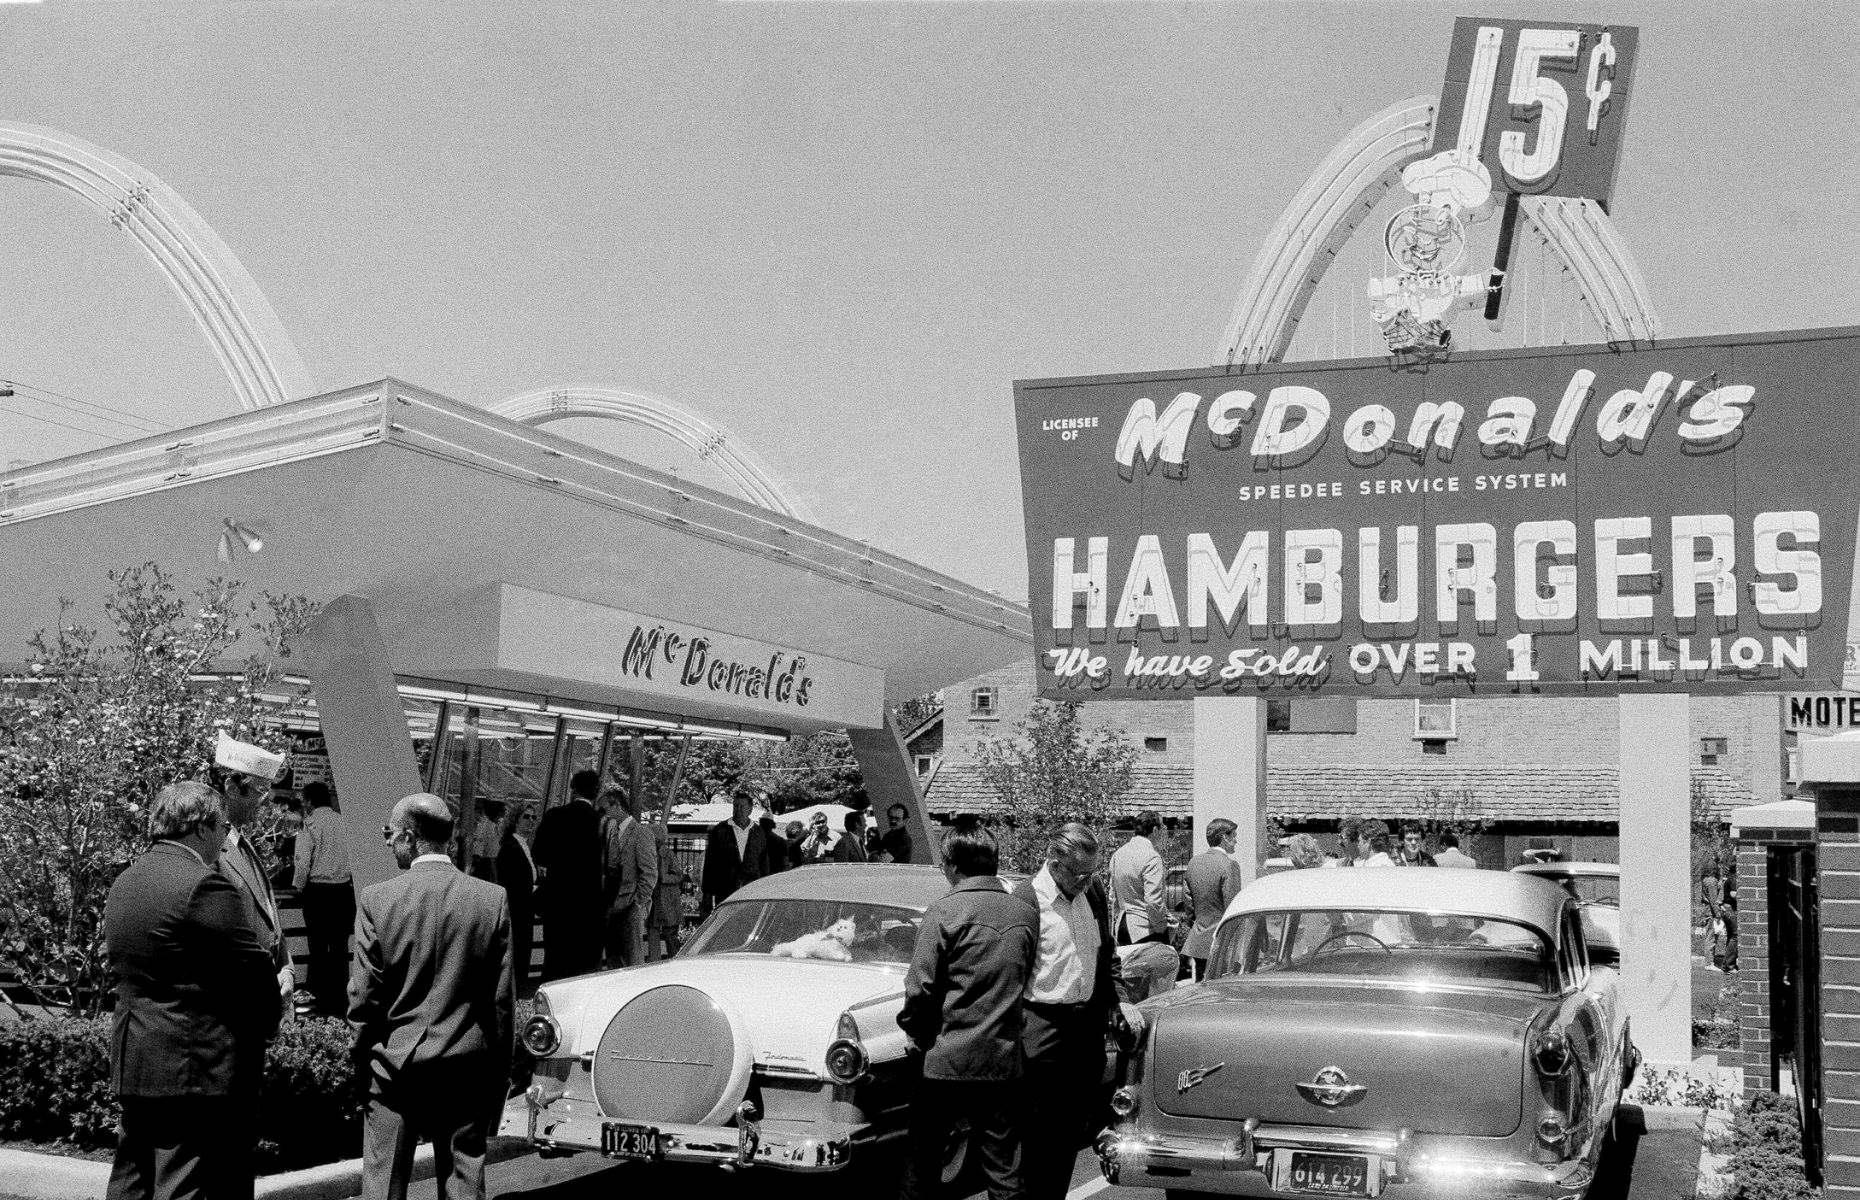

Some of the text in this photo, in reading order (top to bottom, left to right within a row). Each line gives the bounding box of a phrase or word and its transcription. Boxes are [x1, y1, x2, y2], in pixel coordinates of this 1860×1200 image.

[1456, 26, 1617, 182] 15¢
[1042, 416, 1099, 431] LICENSEE
[1061, 429, 1079, 441] OF
[1115, 368, 1757, 467] McDonald's
[1239, 472, 1567, 501] SPEEDEE SERVICE SYSTEM
[1052, 510, 1823, 629] HAMBURGERS
[1049, 648, 1108, 678] We
[1123, 645, 1214, 677] have
[1219, 645, 1328, 680] Sold
[1348, 642, 1477, 675] OVER
[1505, 633, 1540, 682] 1
[1579, 635, 1808, 672] MILLION
[606, 1130, 656, 1155] 112 304
